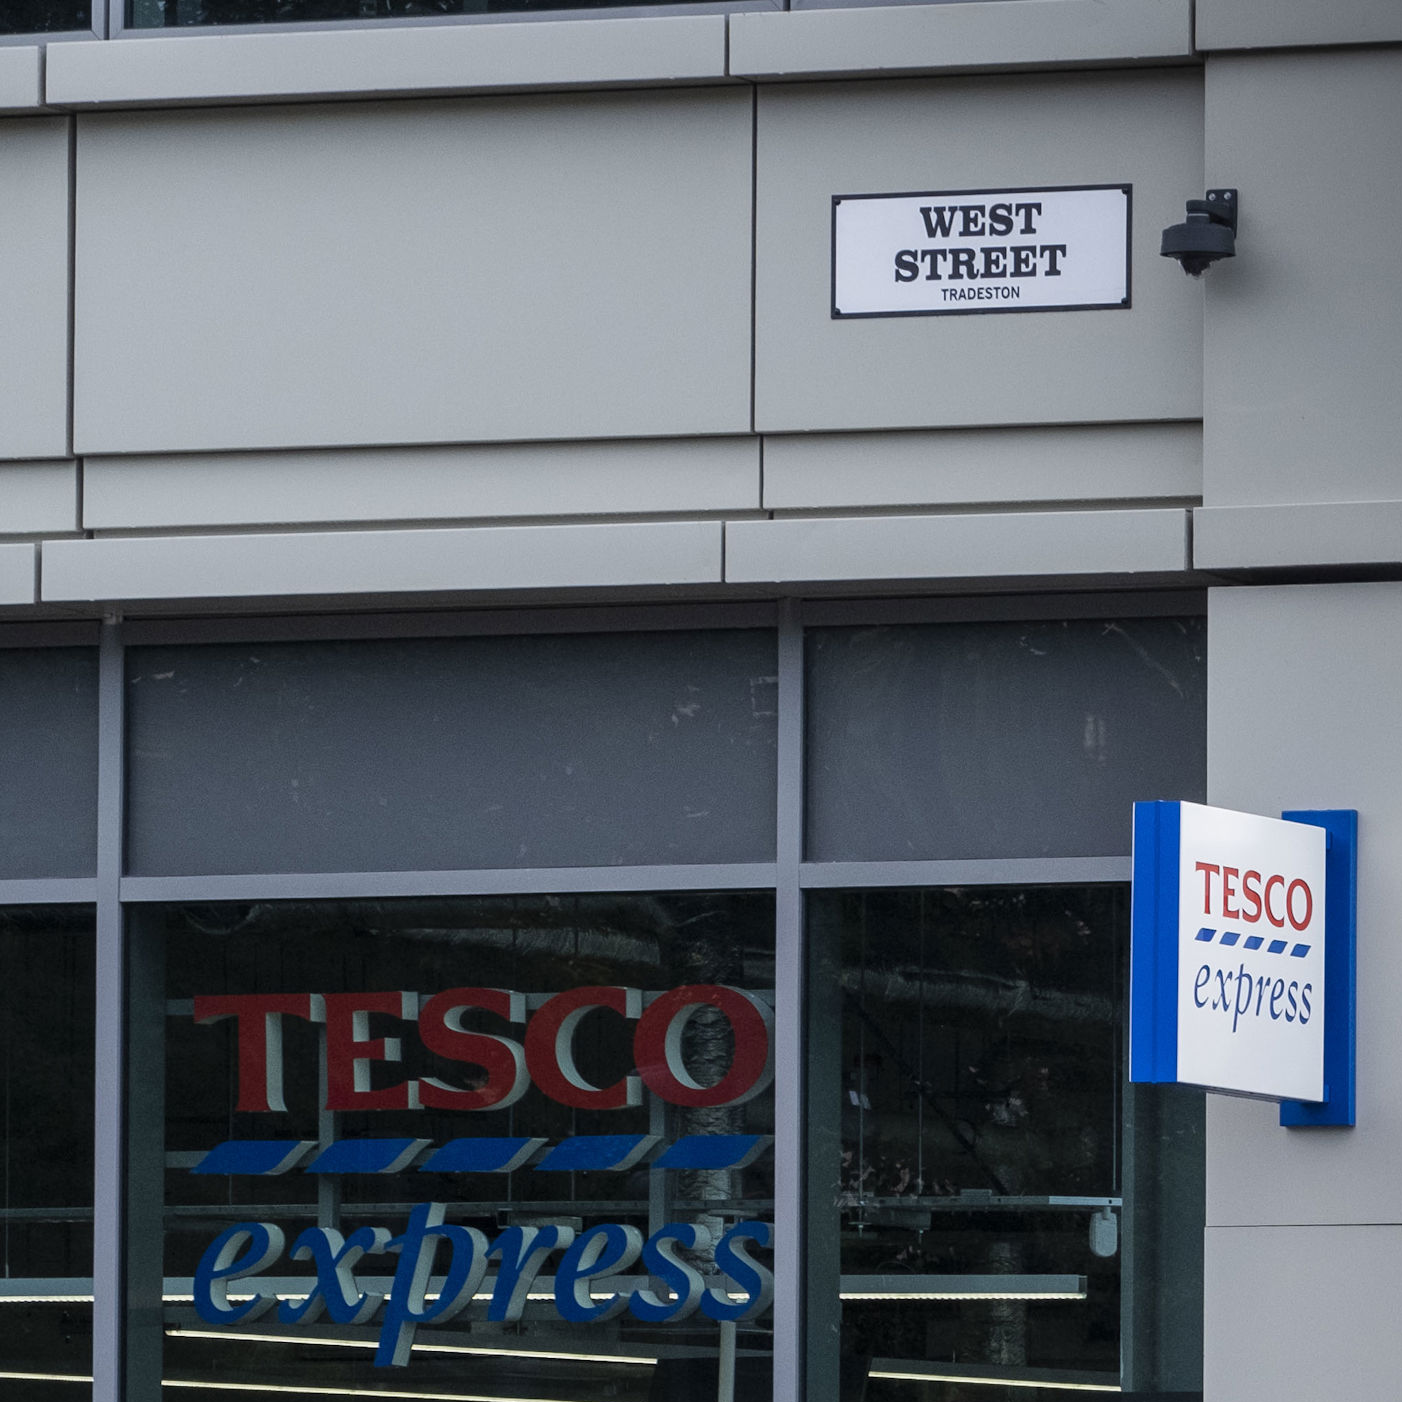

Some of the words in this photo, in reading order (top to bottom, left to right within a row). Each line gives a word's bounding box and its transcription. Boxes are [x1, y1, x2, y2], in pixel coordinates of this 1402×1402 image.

[919, 202, 1042, 239] WEST
[894, 244, 1067, 283] STREET
[941, 286, 1020, 301] TRADESTON
[1194, 861, 1314, 933] TESCO
[1193, 963, 1314, 1033] express
[192, 984, 773, 1113] TESCO
[192, 1202, 773, 1368] express
